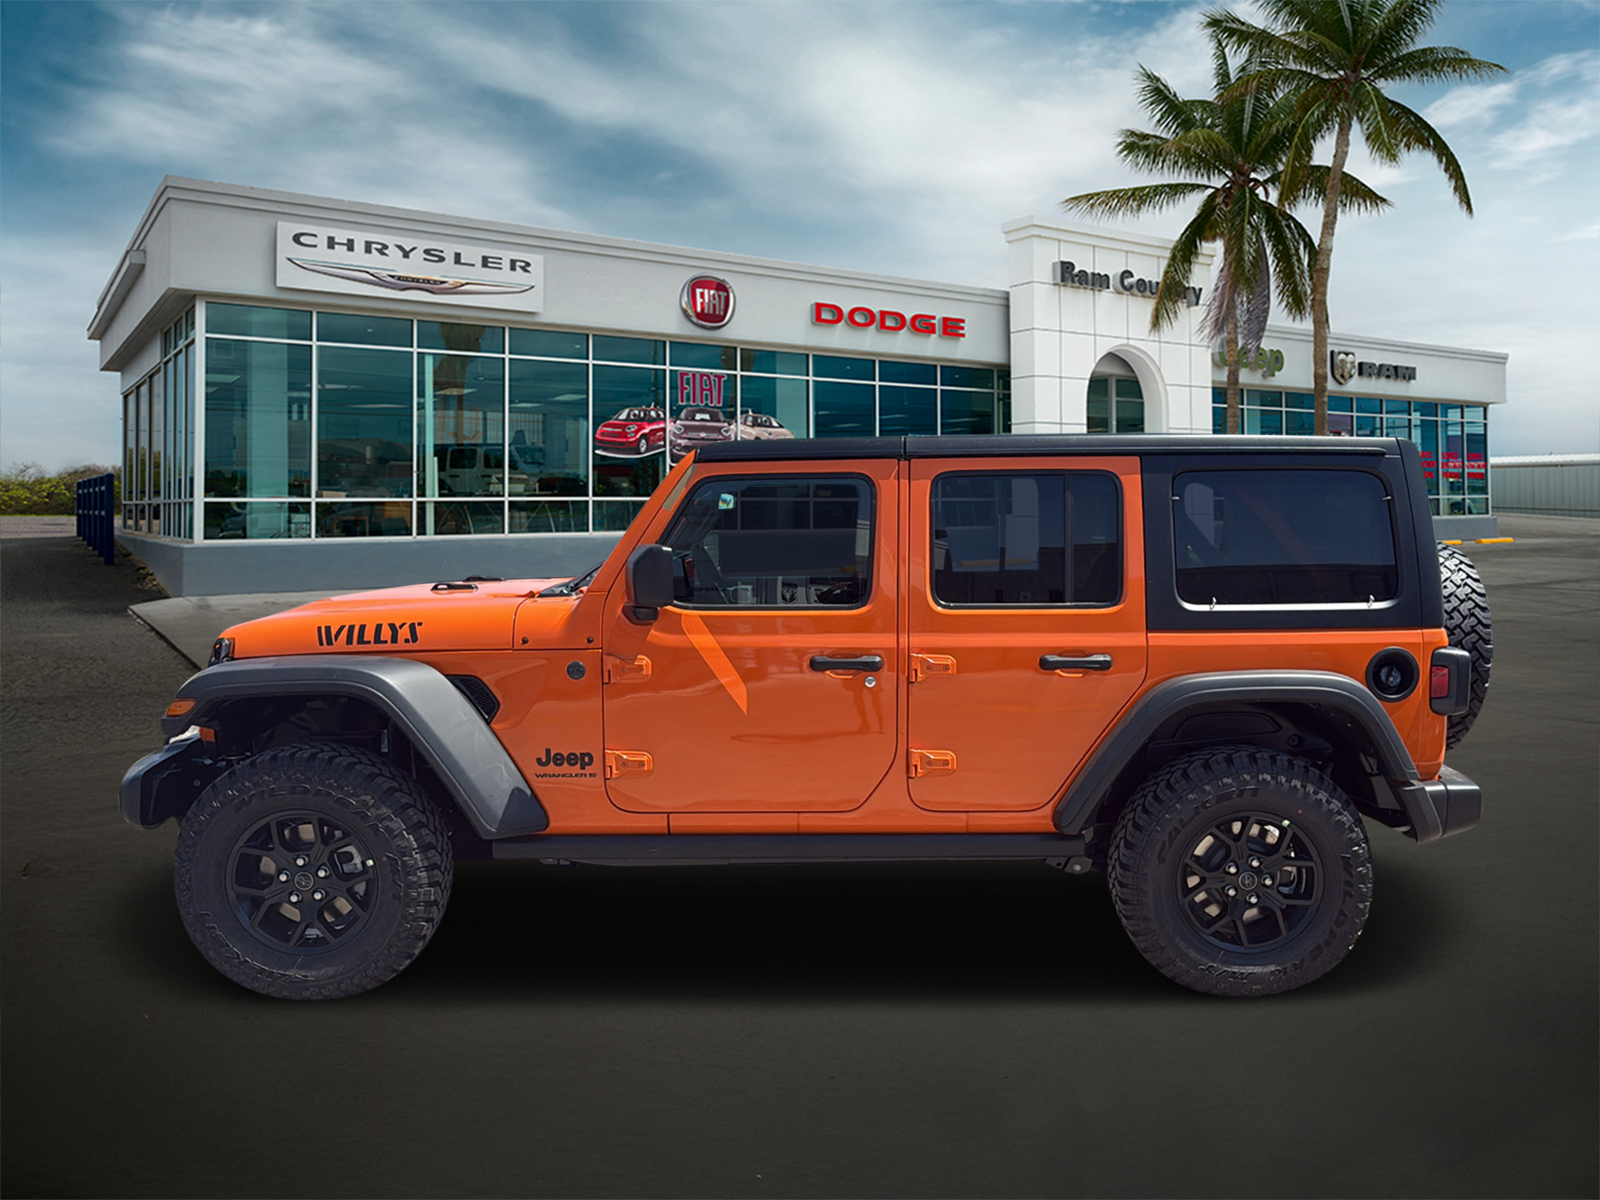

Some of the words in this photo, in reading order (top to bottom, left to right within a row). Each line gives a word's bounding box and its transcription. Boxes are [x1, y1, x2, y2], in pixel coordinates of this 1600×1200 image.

[292, 231, 533, 274] CHRYSLER
[1054, 260, 1110, 291] Ram
[1113, 268, 1203, 308] Coury
[695, 287, 728, 316] FIAT
[812, 301, 967, 339] DODGE
[1357, 361, 1417, 381] RAM
[677, 370, 727, 407] FIAT
[317, 622, 423, 647] WILLYS
[536, 748, 594, 770] Jeep
